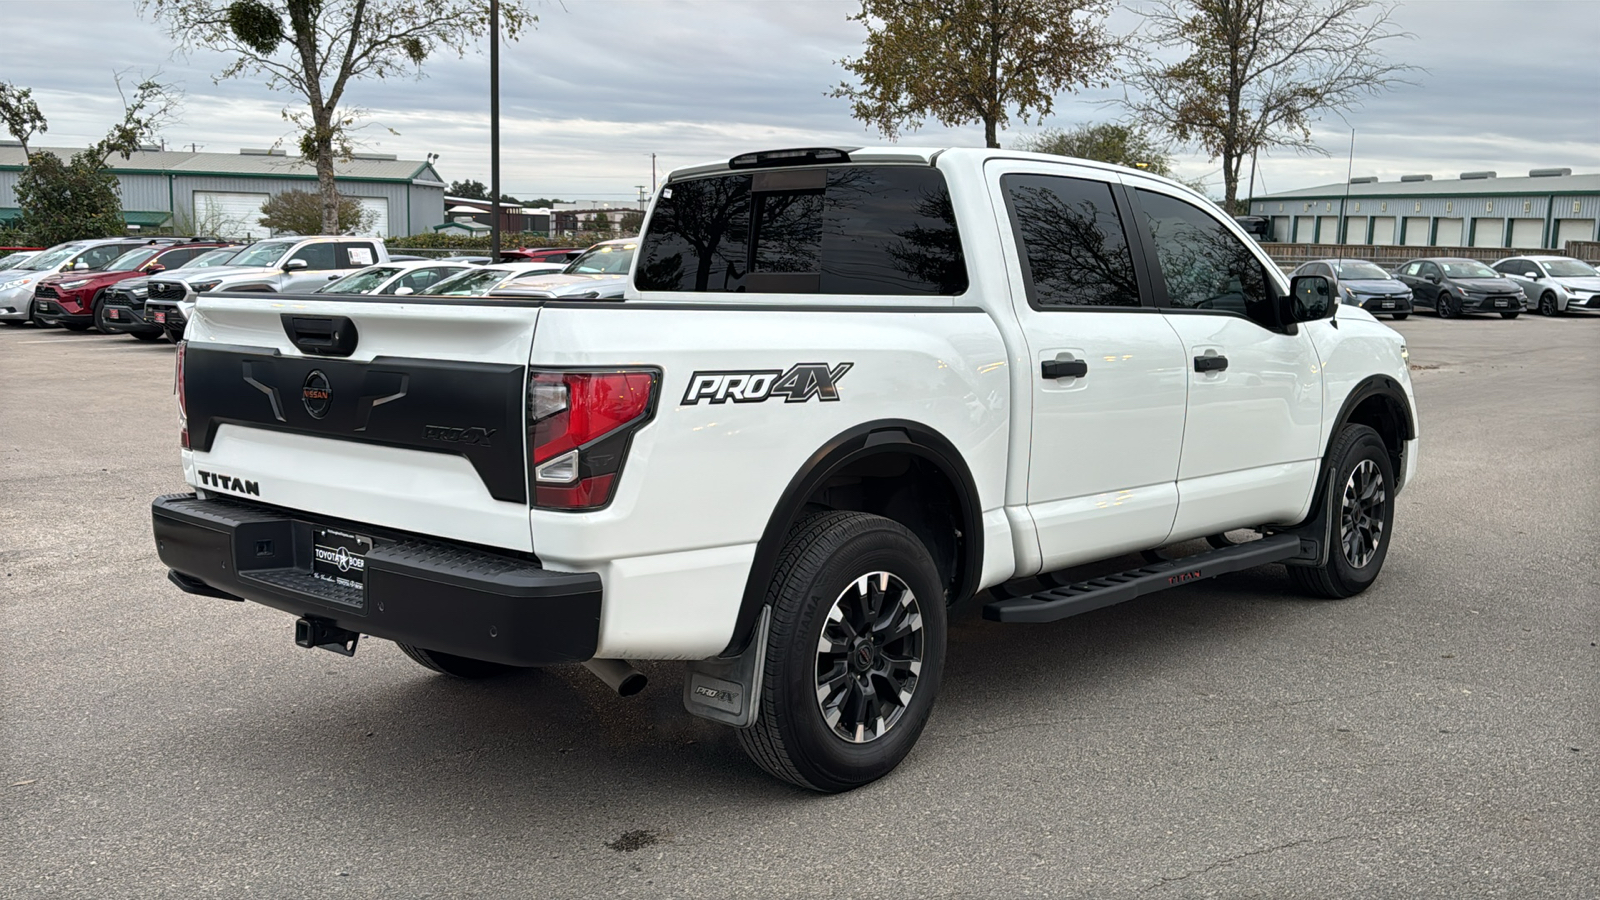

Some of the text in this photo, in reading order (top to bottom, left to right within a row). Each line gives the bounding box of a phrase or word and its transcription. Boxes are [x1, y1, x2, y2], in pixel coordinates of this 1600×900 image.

[303, 389, 329, 399] NISSAN
[198, 469, 260, 496] TITAN
[315, 549, 340, 562] TOYOTA
[1168, 570, 1201, 584] TITAN
